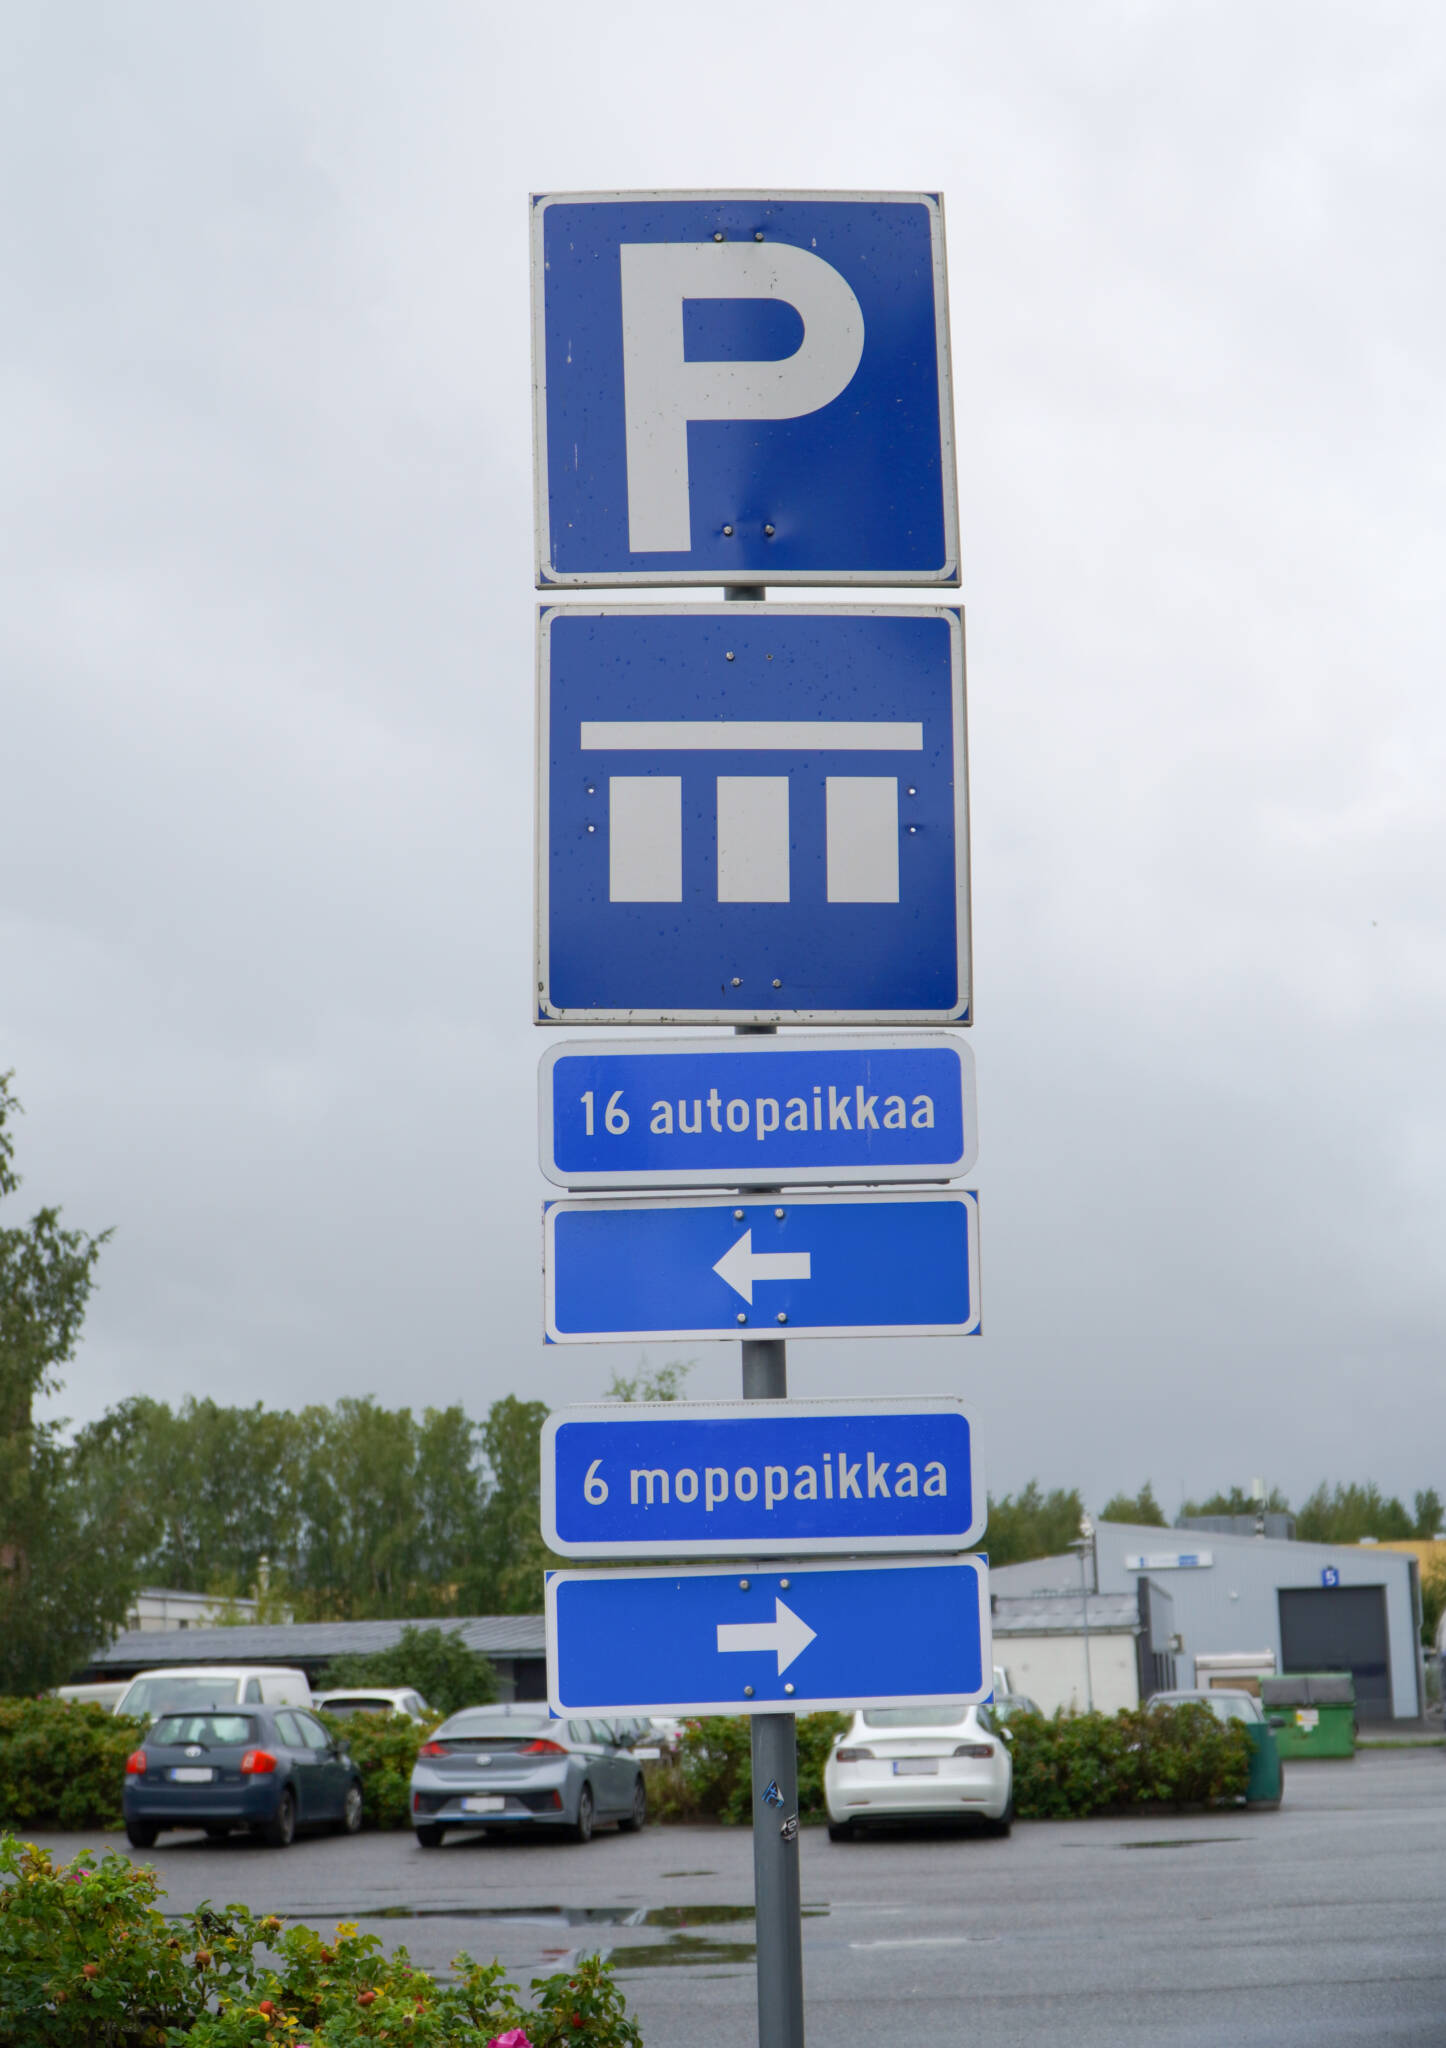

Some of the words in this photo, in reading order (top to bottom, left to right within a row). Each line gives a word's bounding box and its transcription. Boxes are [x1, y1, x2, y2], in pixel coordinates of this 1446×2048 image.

[620, 242, 864, 552] P
[580, 1090, 630, 1136] 16
[650, 1085, 935, 1140] autopaikkaa
[583, 1459, 609, 1505] 6
[630, 1453, 947, 1511] mopopaikkaa
[1325, 1570, 1336, 1585] 5
